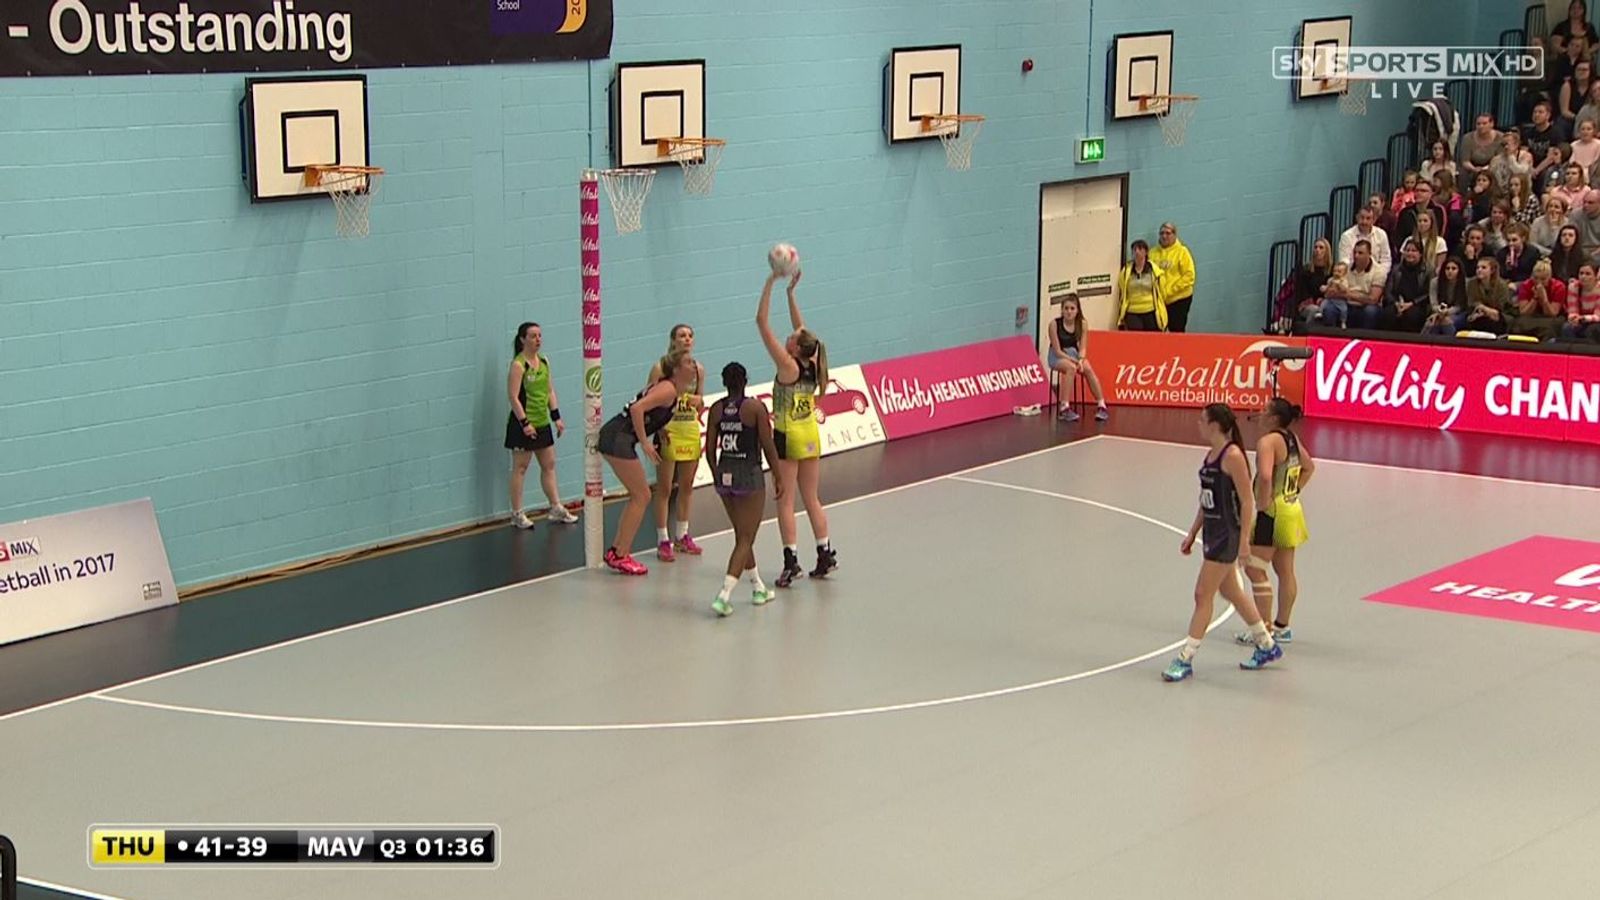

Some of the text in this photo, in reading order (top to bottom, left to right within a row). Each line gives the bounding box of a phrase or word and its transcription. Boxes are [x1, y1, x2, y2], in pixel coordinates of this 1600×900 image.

[497, 0, 520, 10] School
[49, 0, 353, 62] Outstanding
[1115, 356, 1281, 390] netballuk
[1315, 339, 1600, 430] Vitality CHAN
[872, 364, 1044, 417] Vitality HEALTH INSURANCE
[1115, 387, 1286, 405] www.netballuk.co.
[722, 433, 739, 451] GK
[10, 538, 39, 556] MIX
[0, 553, 116, 593] etball in 2017
